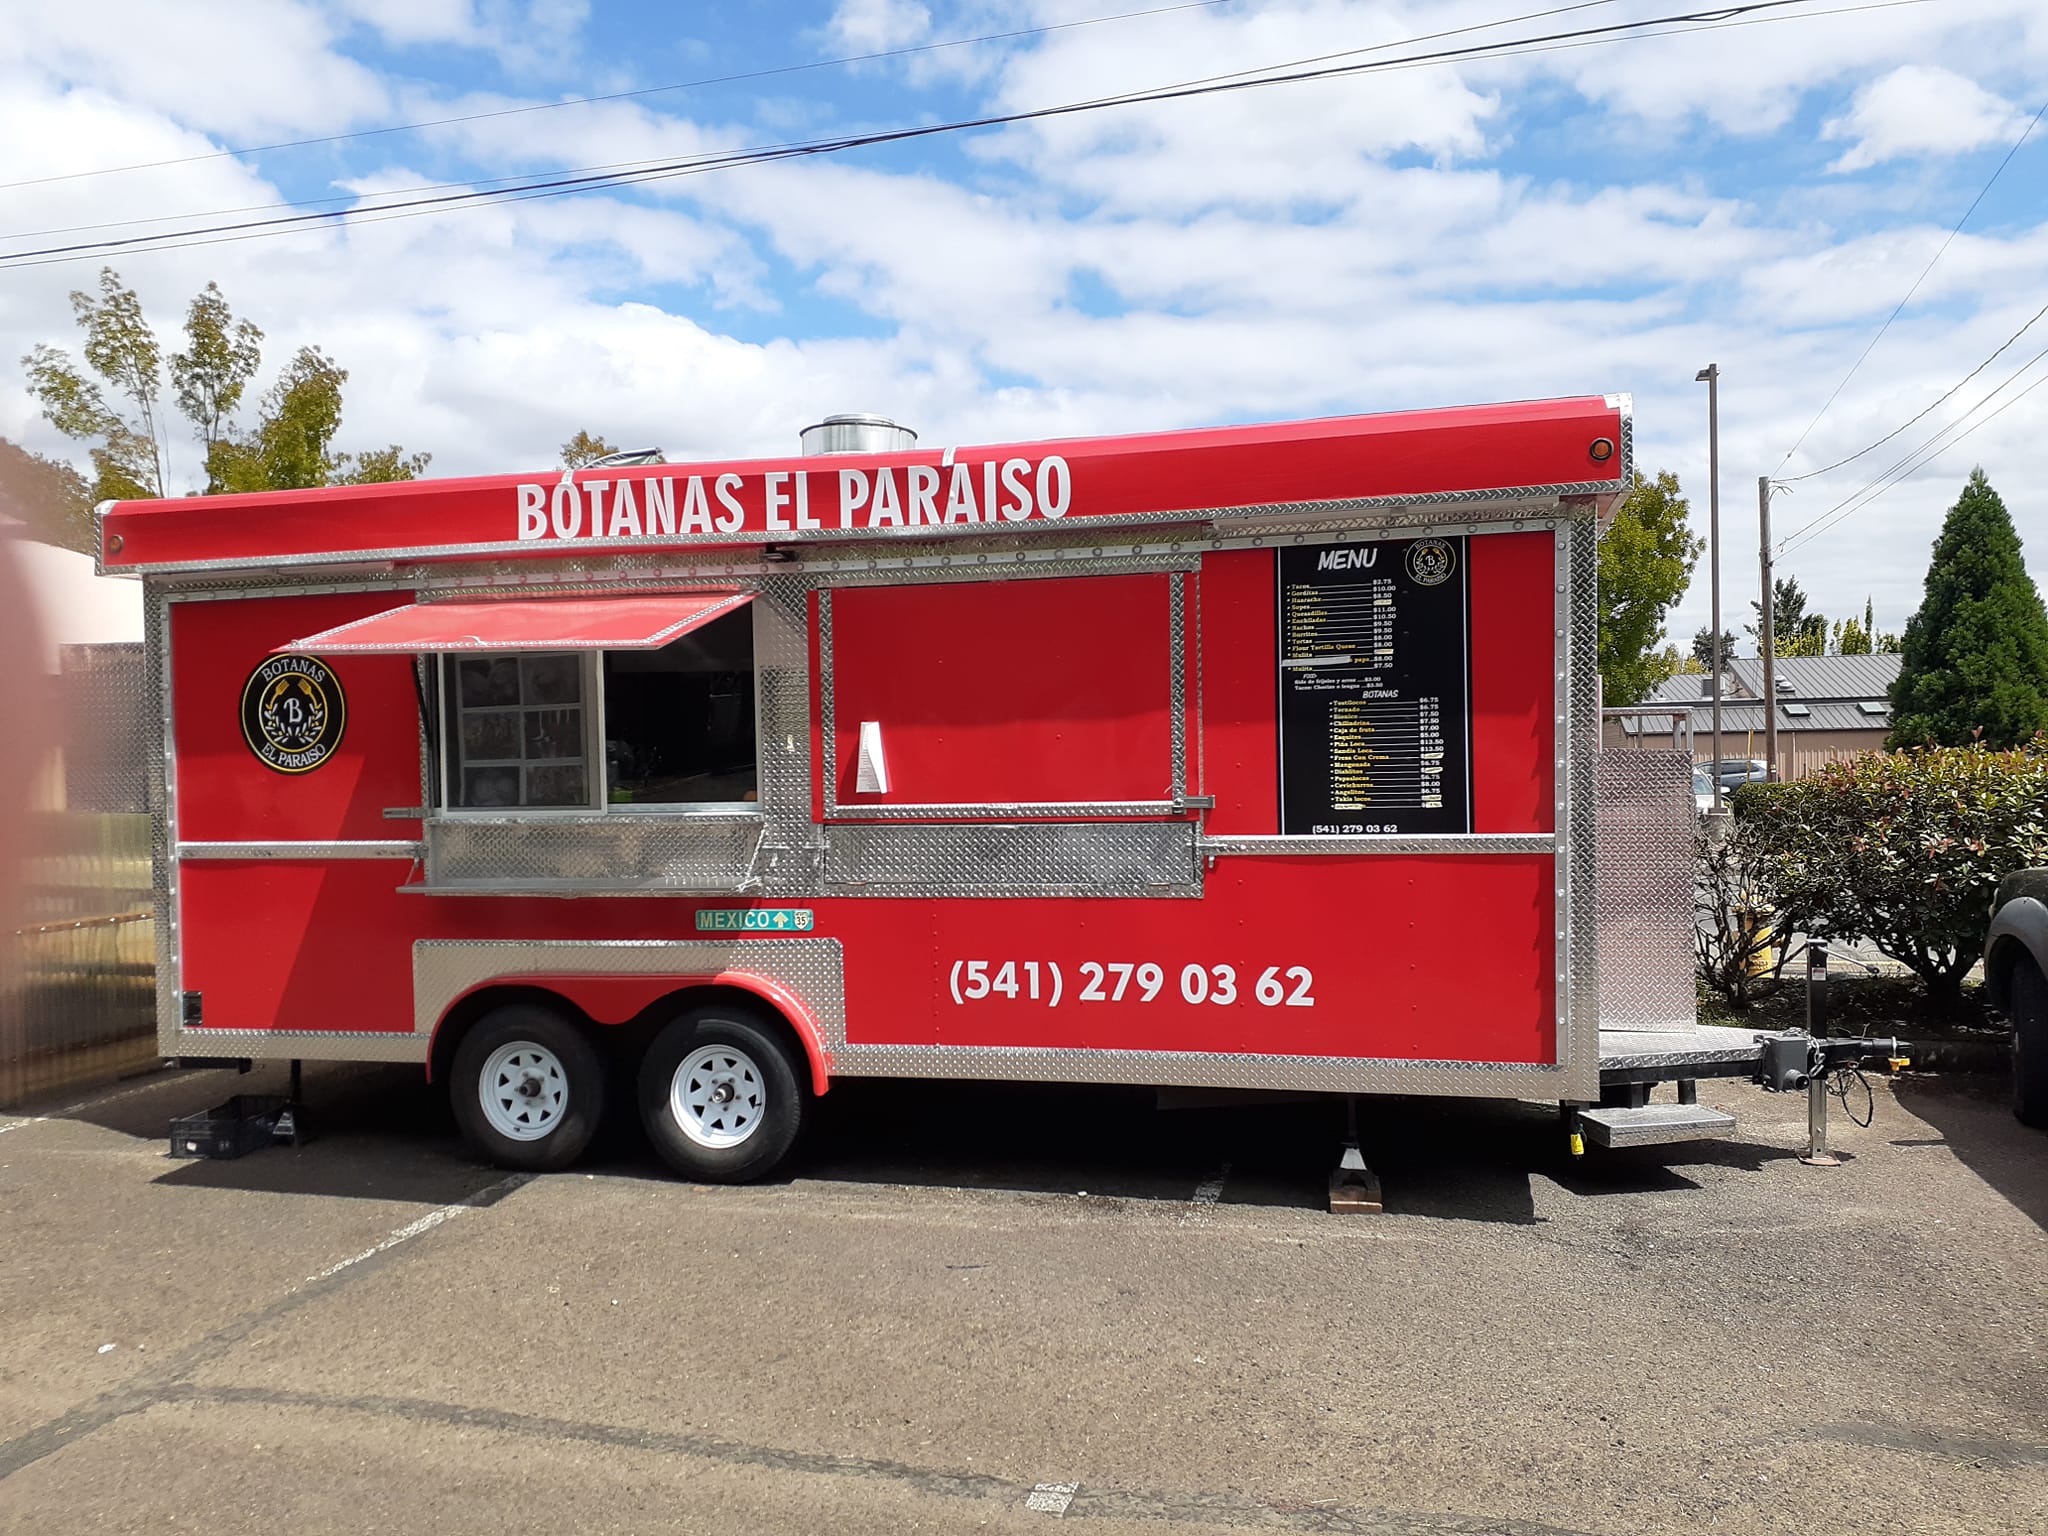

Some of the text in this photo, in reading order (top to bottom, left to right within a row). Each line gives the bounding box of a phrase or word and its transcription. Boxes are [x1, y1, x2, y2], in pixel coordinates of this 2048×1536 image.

[517, 456, 1071, 540] BOTANAS EL PARAISO
[1415, 540, 1446, 550] BOTANAS
[1318, 548, 1378, 570] MENU
[262, 659, 325, 682] BOTANAS
[1362, 690, 1399, 698] BOTANAS
[284, 698, 303, 722] B
[262, 742, 326, 767] EL PARAISO
[1312, 824, 1398, 834] (541) 279 03 62
[700, 912, 806, 928] MEXICO 35
[950, 960, 1315, 1007] (541) 279 03 62
